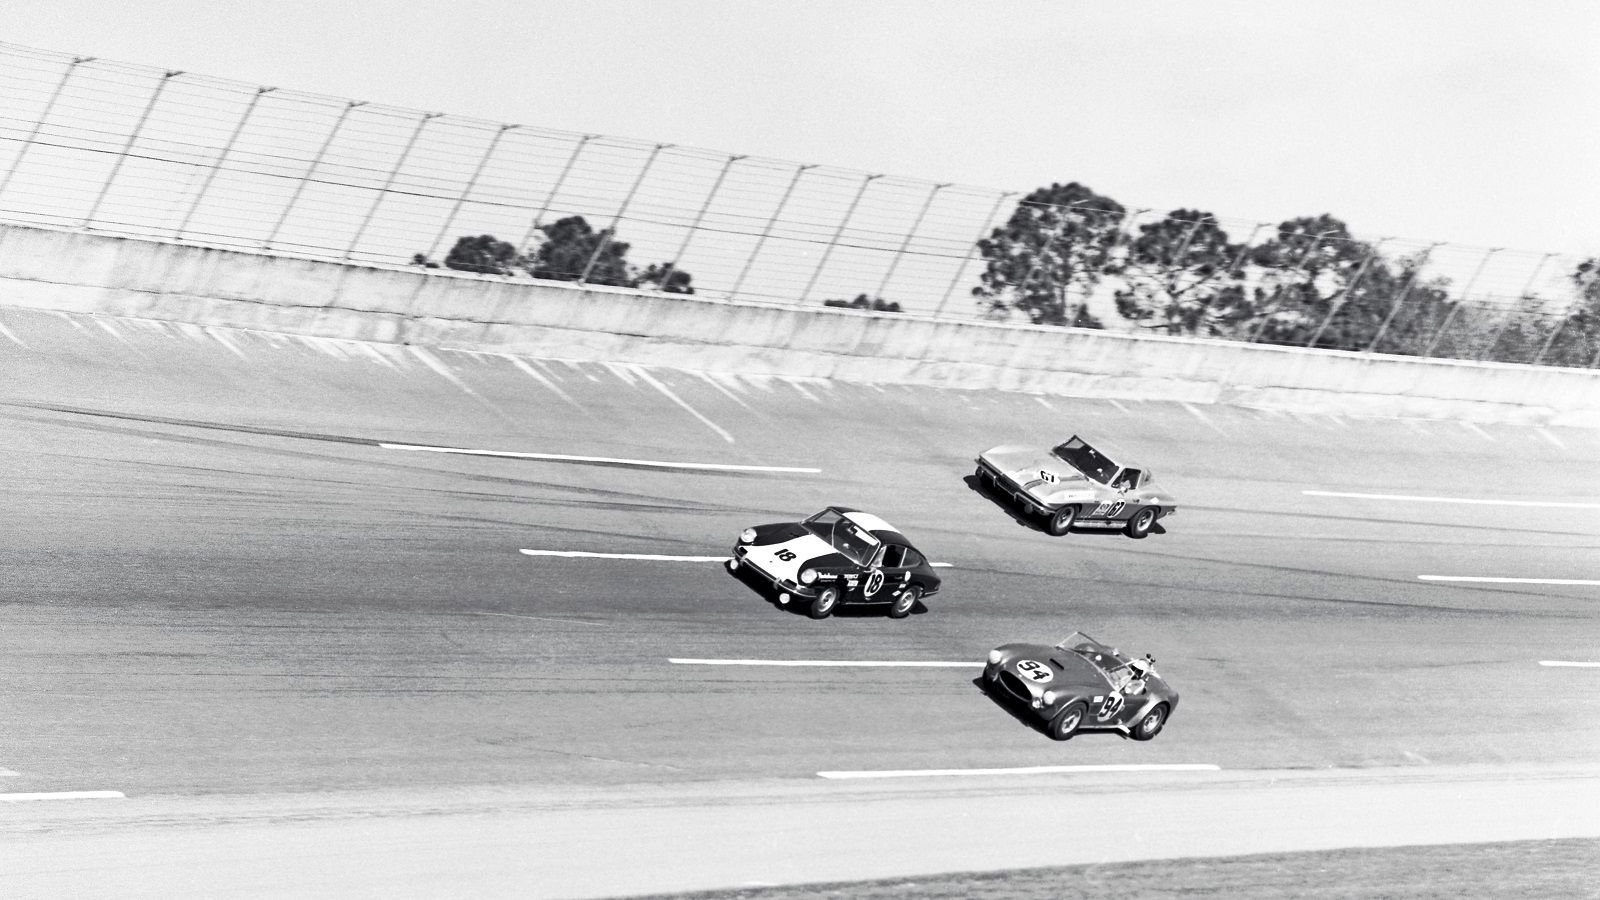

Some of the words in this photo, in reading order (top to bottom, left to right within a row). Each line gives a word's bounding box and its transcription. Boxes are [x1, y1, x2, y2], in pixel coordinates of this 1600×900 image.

[774, 549, 797, 562] 18
[866, 573, 883, 594] 18
[1018, 661, 1050, 680] 94
[1099, 696, 1123, 718] 94
